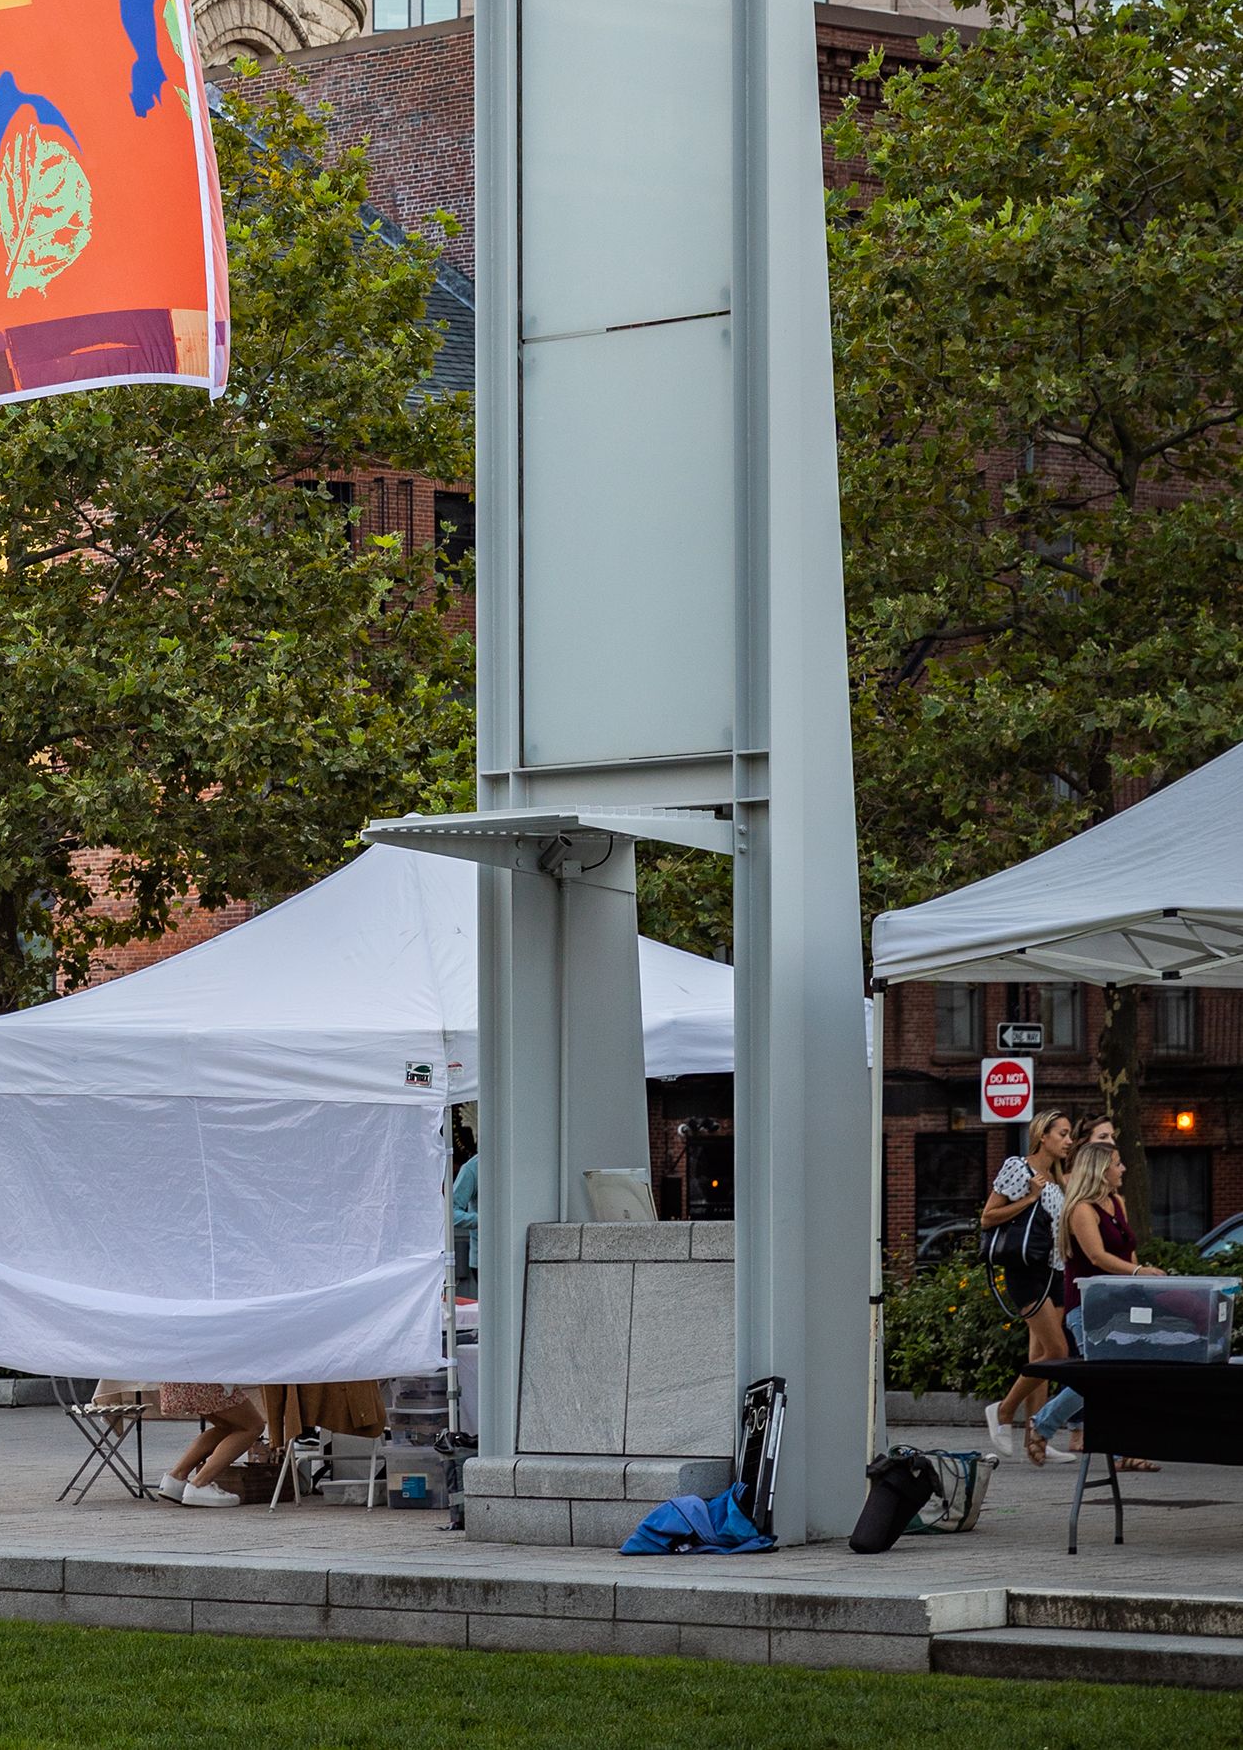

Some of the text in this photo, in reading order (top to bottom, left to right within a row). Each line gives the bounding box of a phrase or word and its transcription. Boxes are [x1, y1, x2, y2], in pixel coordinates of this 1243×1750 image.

[1027, 1032, 1039, 1042] WAY
[990, 1073, 1025, 1084] DO NOT
[993, 1096, 1022, 1107] ENTER
